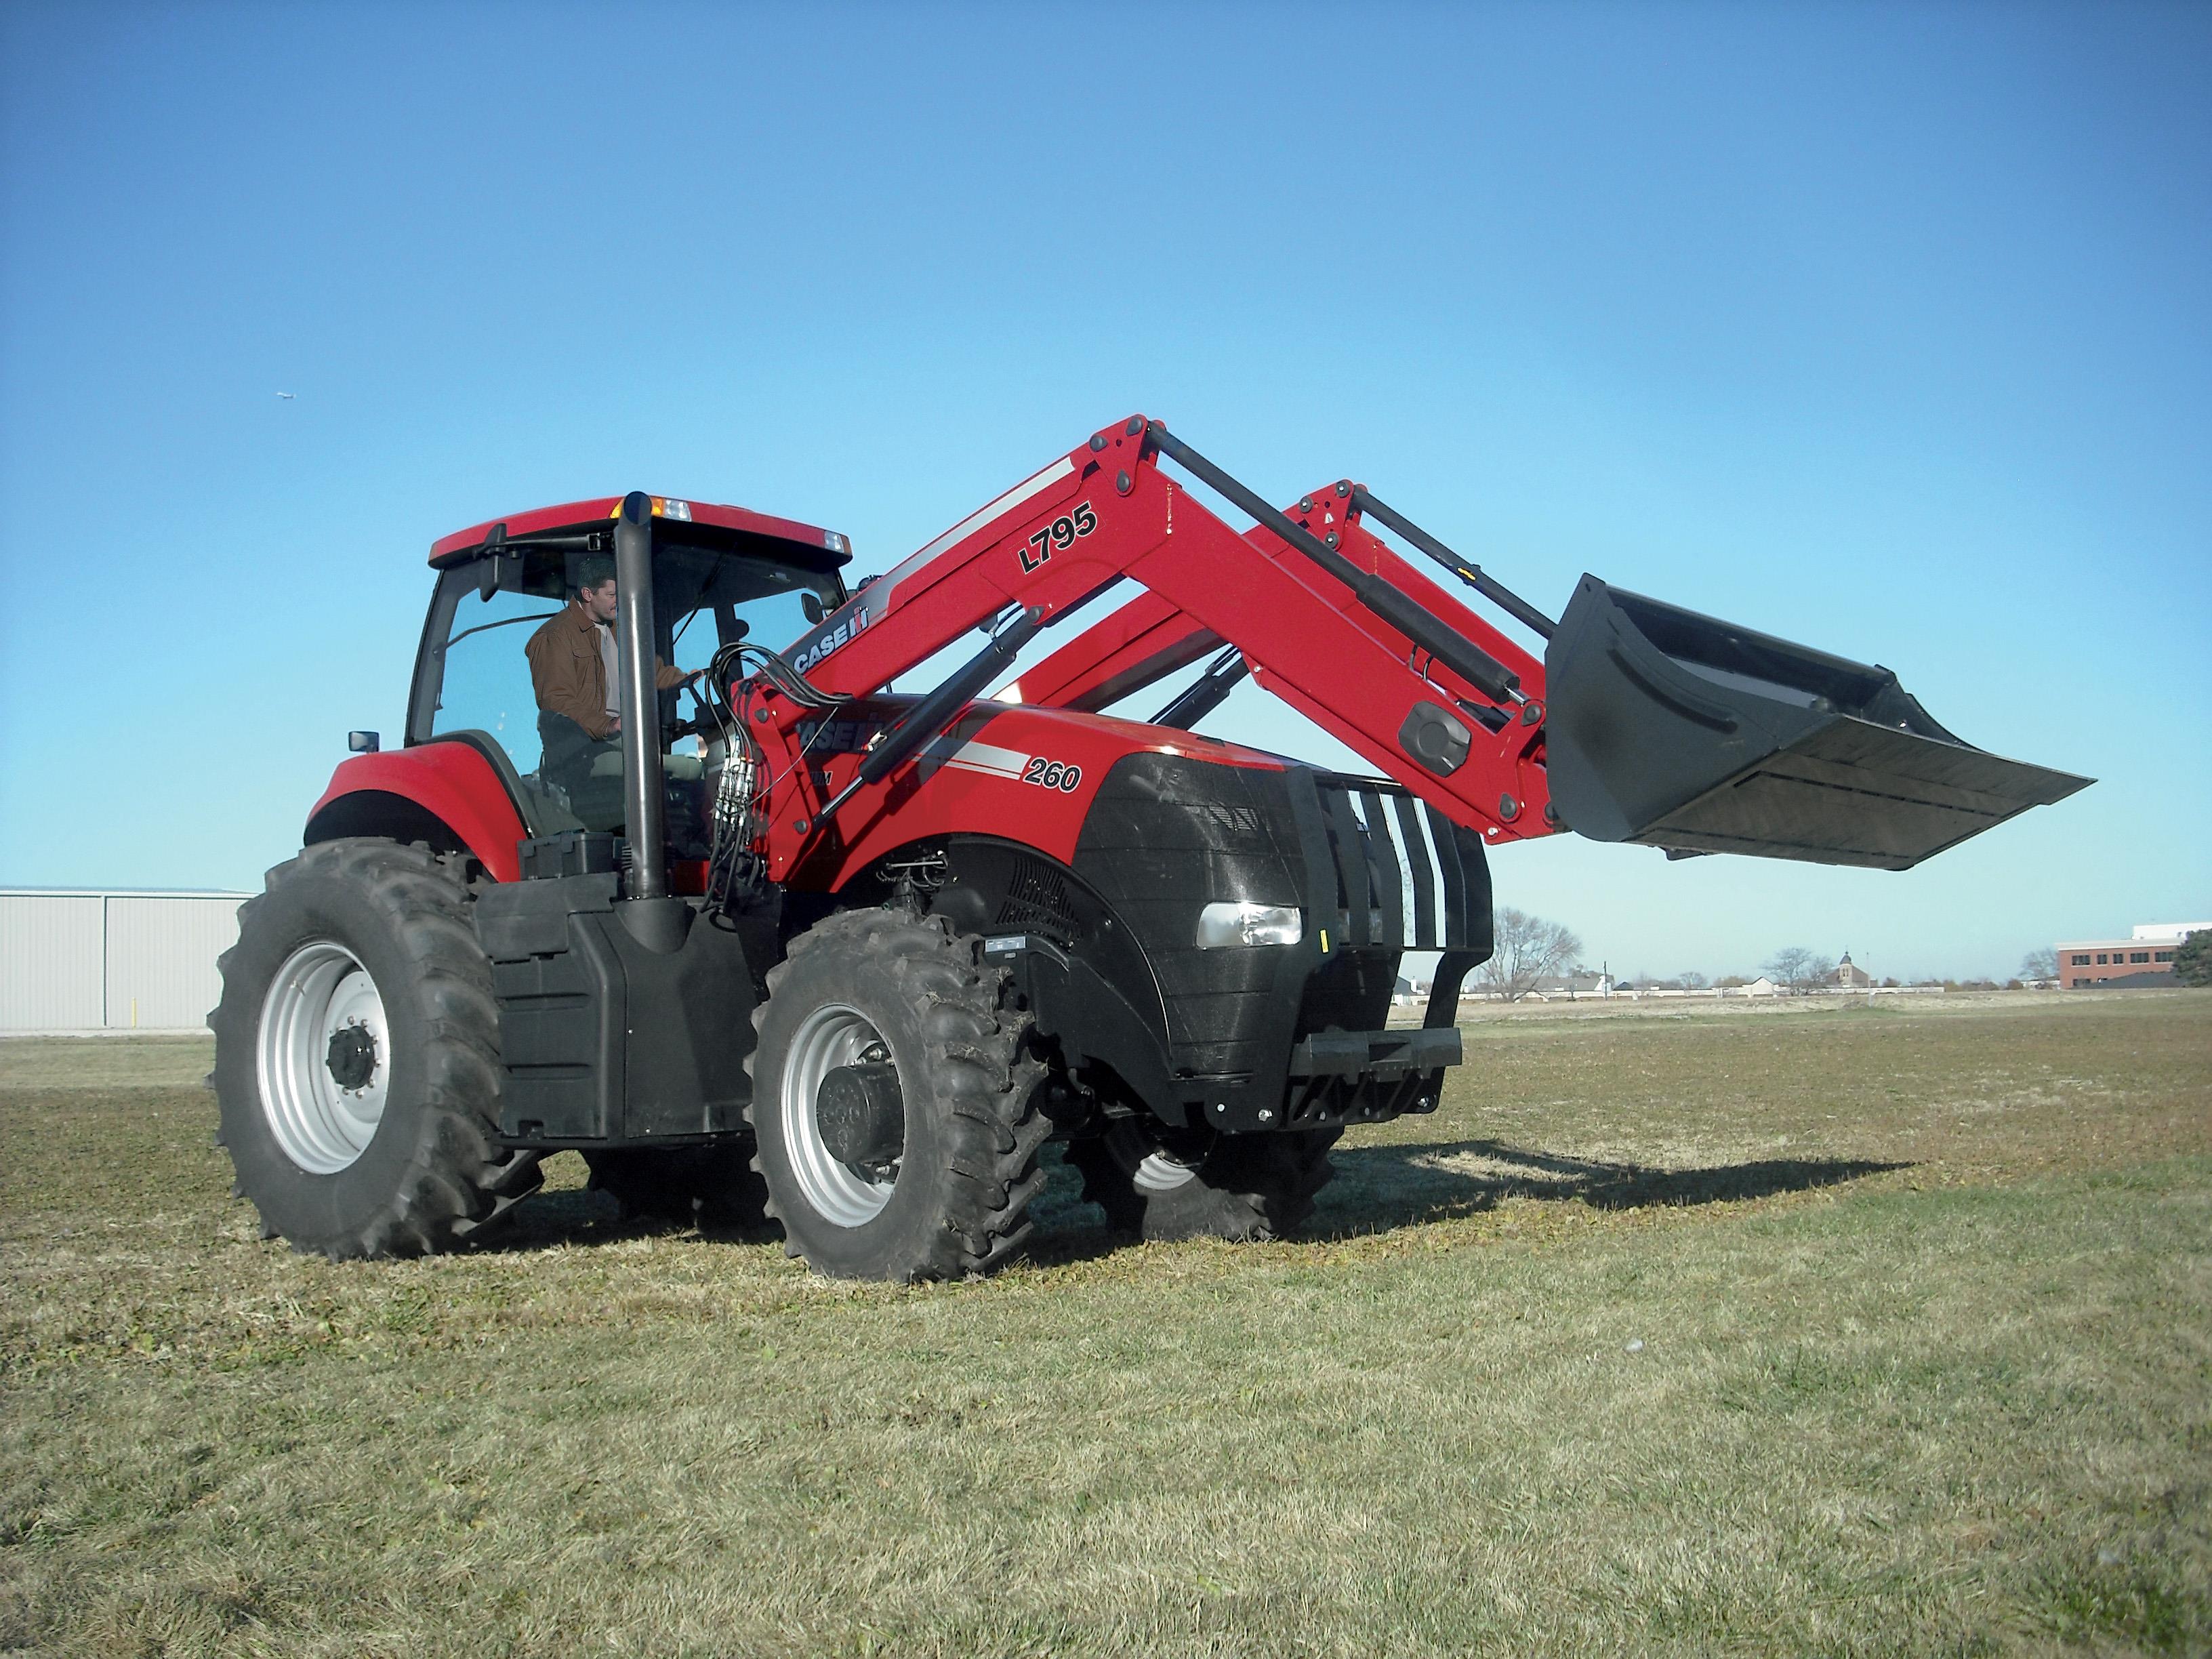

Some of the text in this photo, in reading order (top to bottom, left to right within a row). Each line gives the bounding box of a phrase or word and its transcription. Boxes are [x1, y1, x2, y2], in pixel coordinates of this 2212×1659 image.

[1017, 499, 1097, 575] L795
[794, 623, 848, 675] CASE
[1022, 756, 1082, 794] 260
